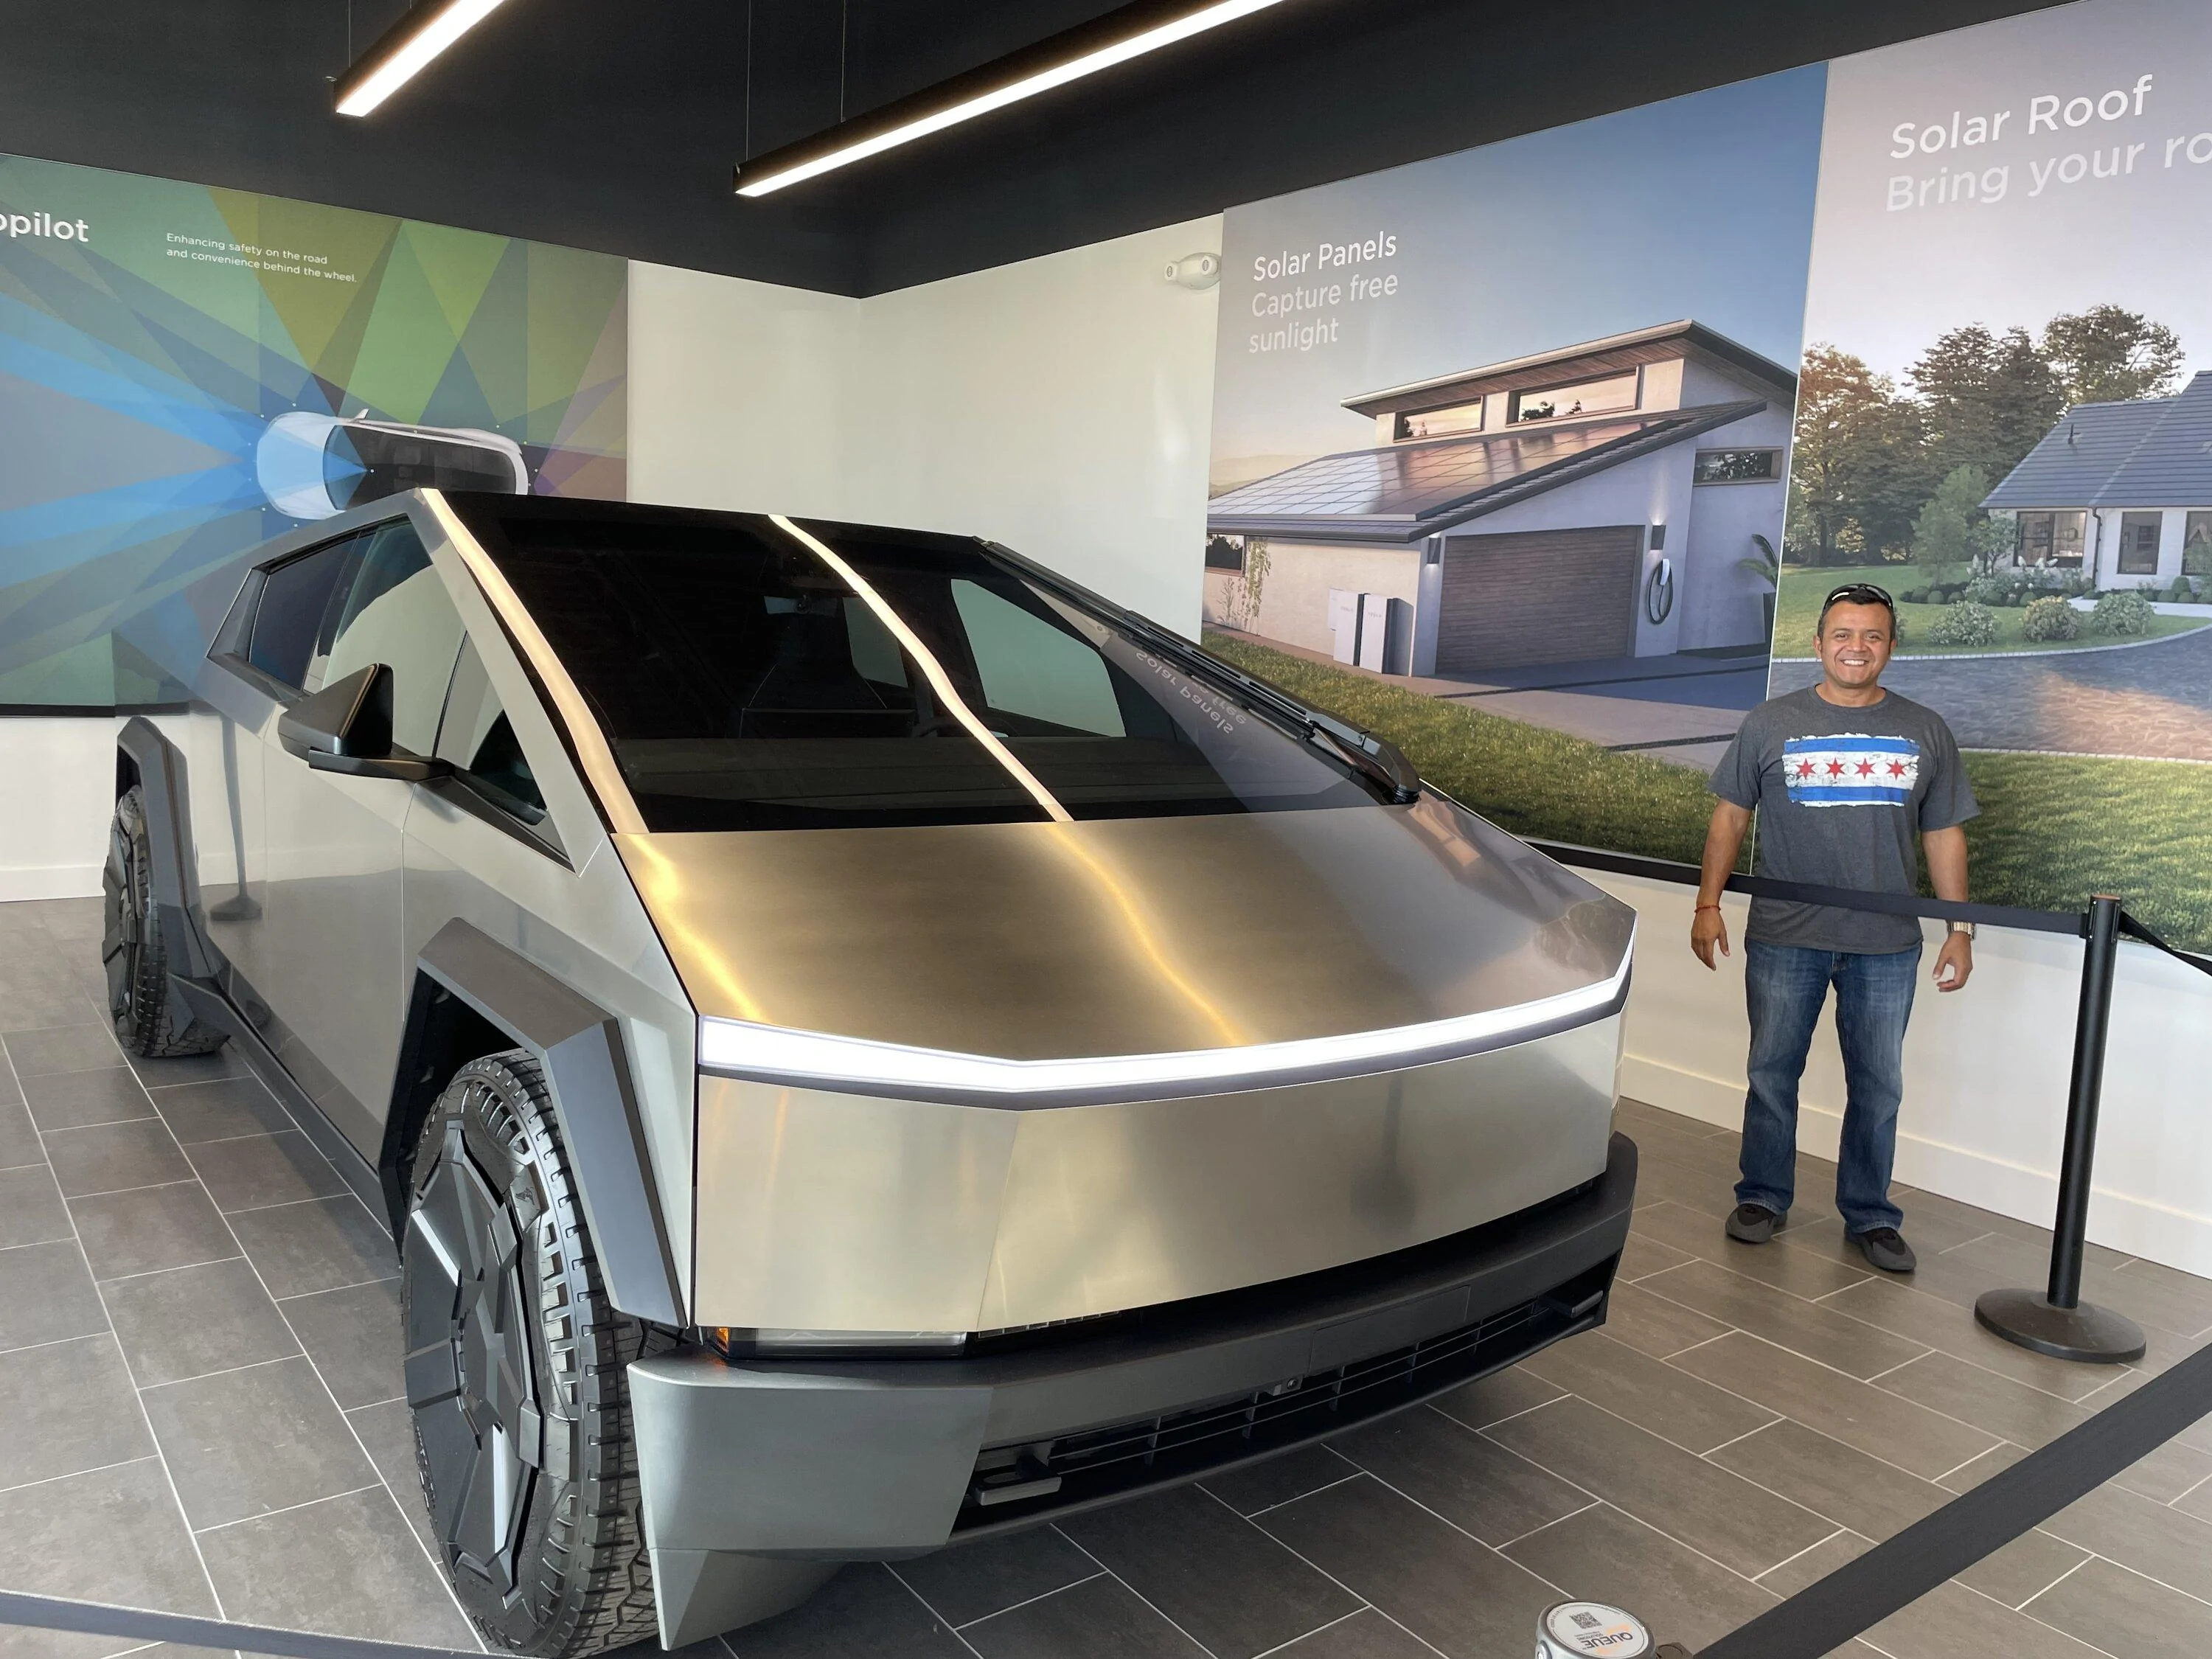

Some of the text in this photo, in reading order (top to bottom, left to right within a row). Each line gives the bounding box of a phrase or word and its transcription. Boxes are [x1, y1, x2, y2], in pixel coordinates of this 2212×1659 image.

[1889, 73, 2153, 159] Solar Roof
[1886, 133, 2212, 211] Bring your ro
[166, 232, 328, 265] Enhancing safety on the road
[166, 246, 358, 283] and convenience behind the wheel.
[1253, 230, 1398, 282] Solar Panels
[1252, 274, 1399, 318] Capture free
[1248, 317, 1339, 354] sunlight
[1581, 1632, 1633, 1649] QUEUE
